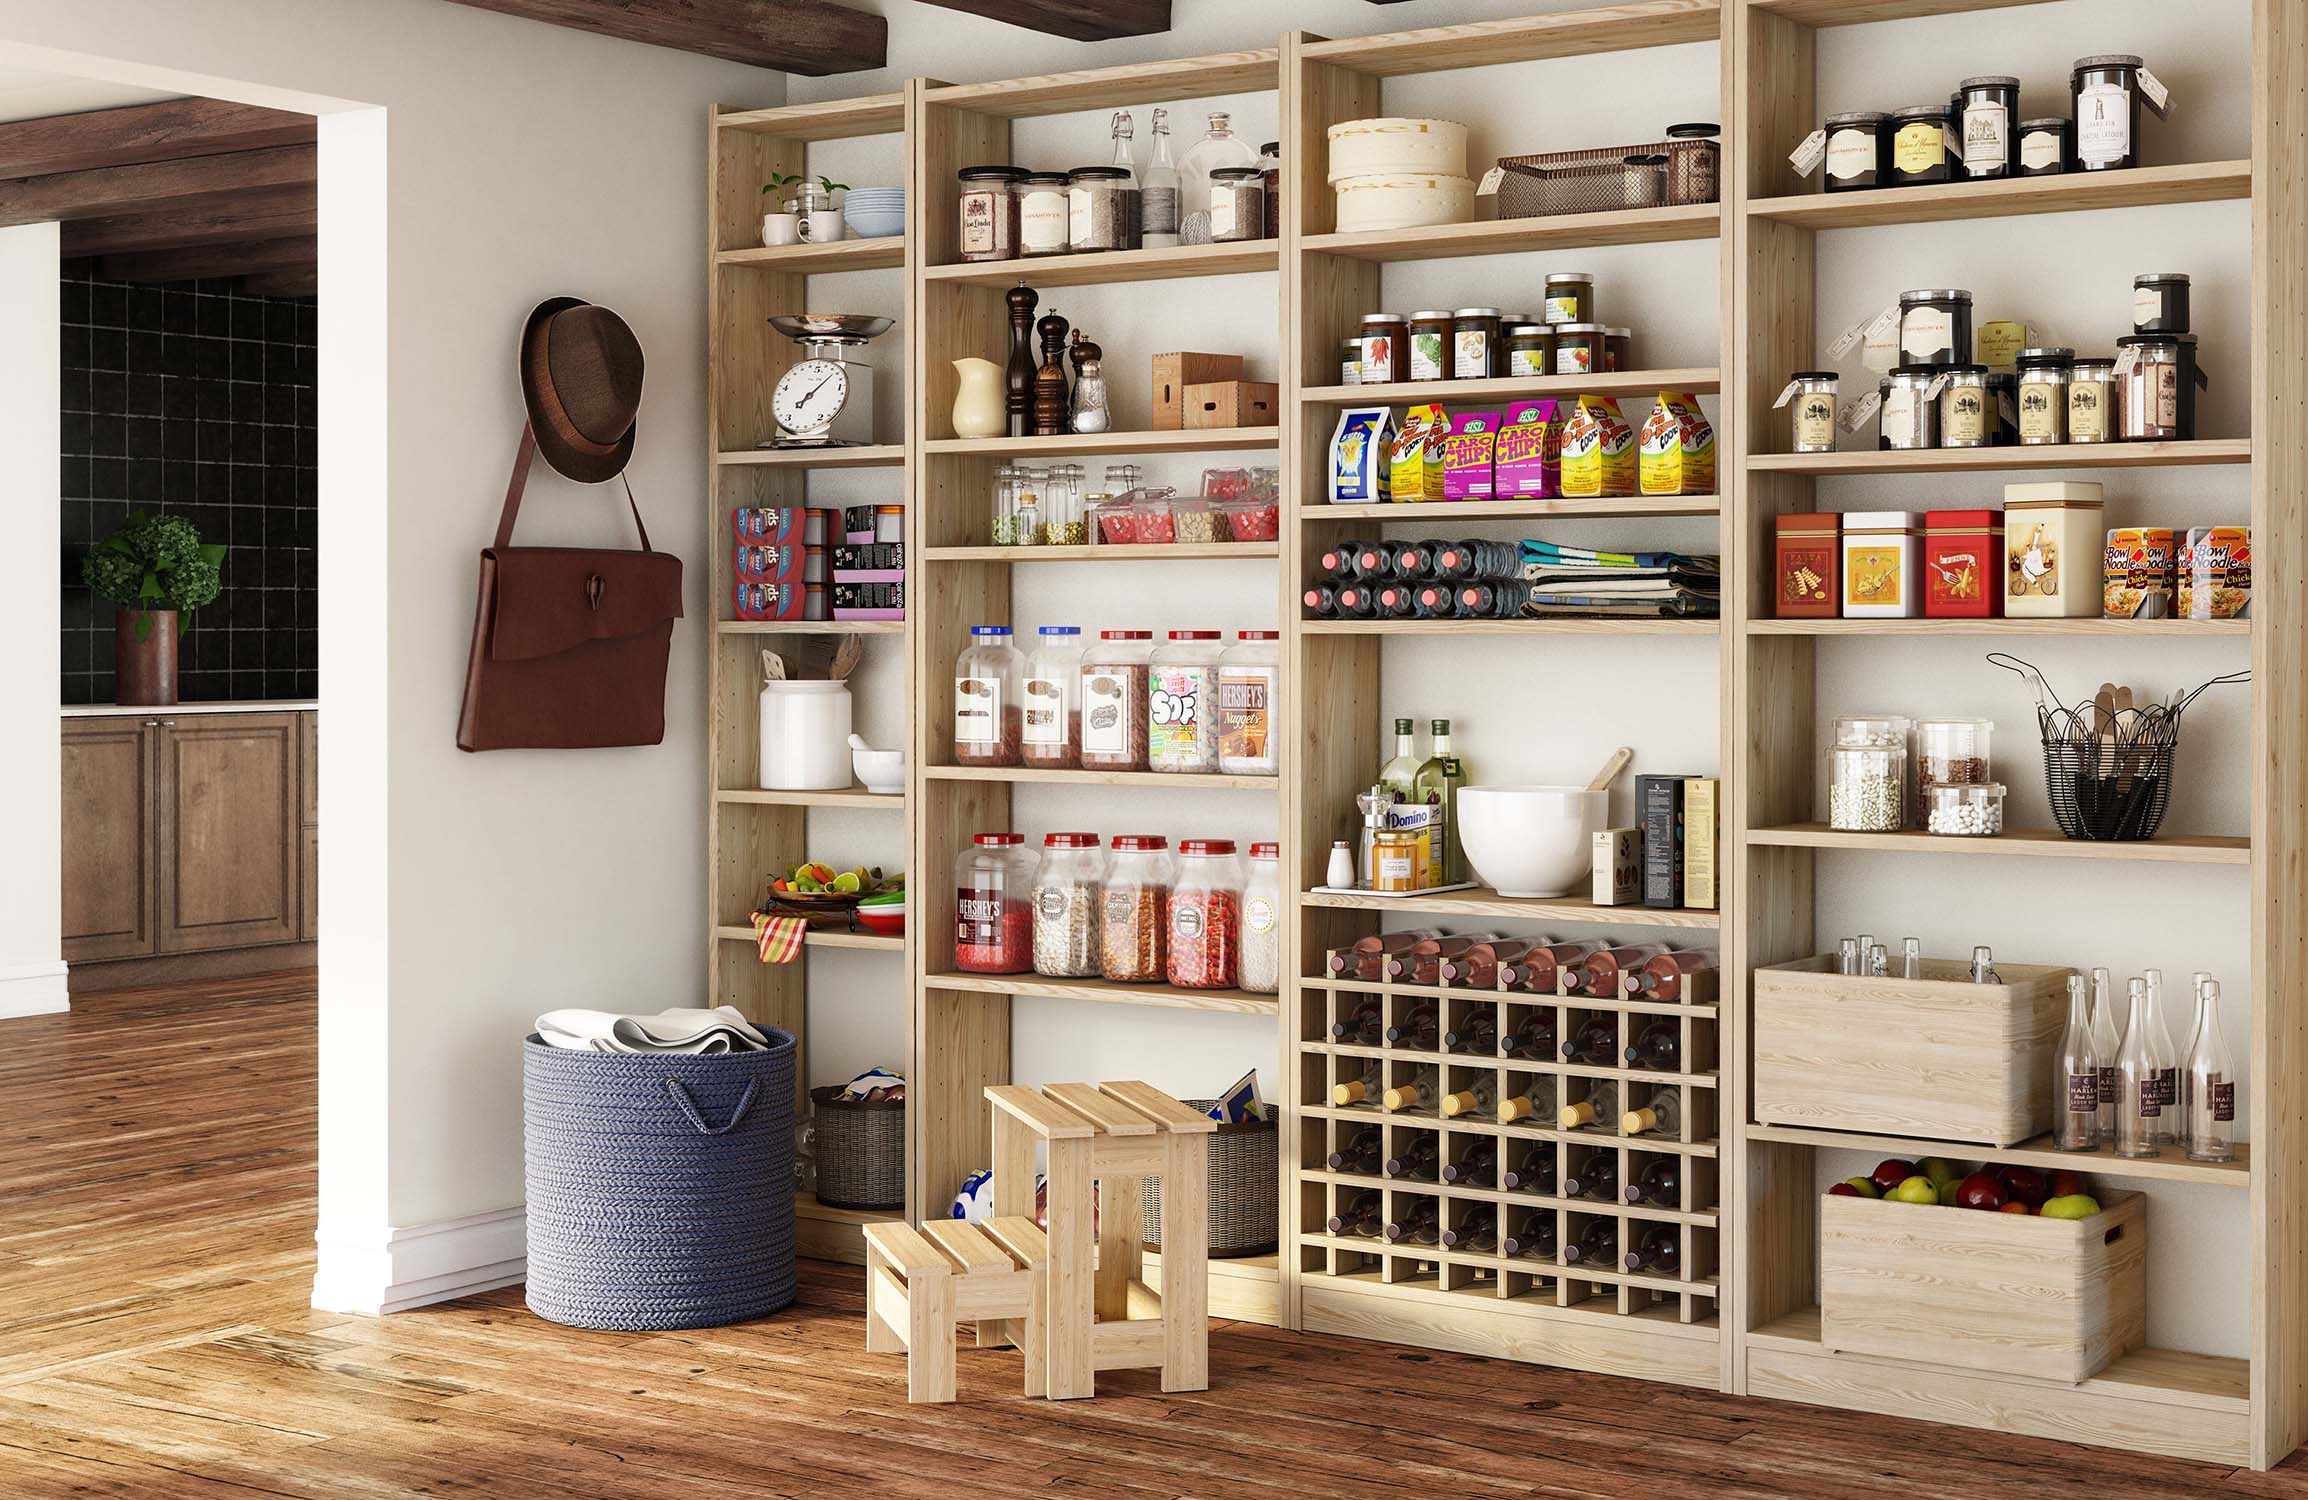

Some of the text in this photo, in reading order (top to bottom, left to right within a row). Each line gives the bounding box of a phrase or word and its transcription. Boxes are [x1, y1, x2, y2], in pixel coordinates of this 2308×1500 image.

[1499, 426, 1544, 441] TARO
[1447, 436, 1493, 450] TARO
[1497, 437, 1543, 462] CHIPS
[1445, 444, 1492, 467] CHIPS
[2105, 545, 2131, 559] Bowl
[2147, 545, 2168, 558] owl
[2196, 543, 2232, 557] Bowl
[2104, 557, 2137, 570] Noodle
[2193, 556, 2239, 569] Noodle
[2226, 573, 2252, 584] Chick
[1391, 811, 1427, 828] Domino
[959, 899, 1000, 917] HERSHEY'S
